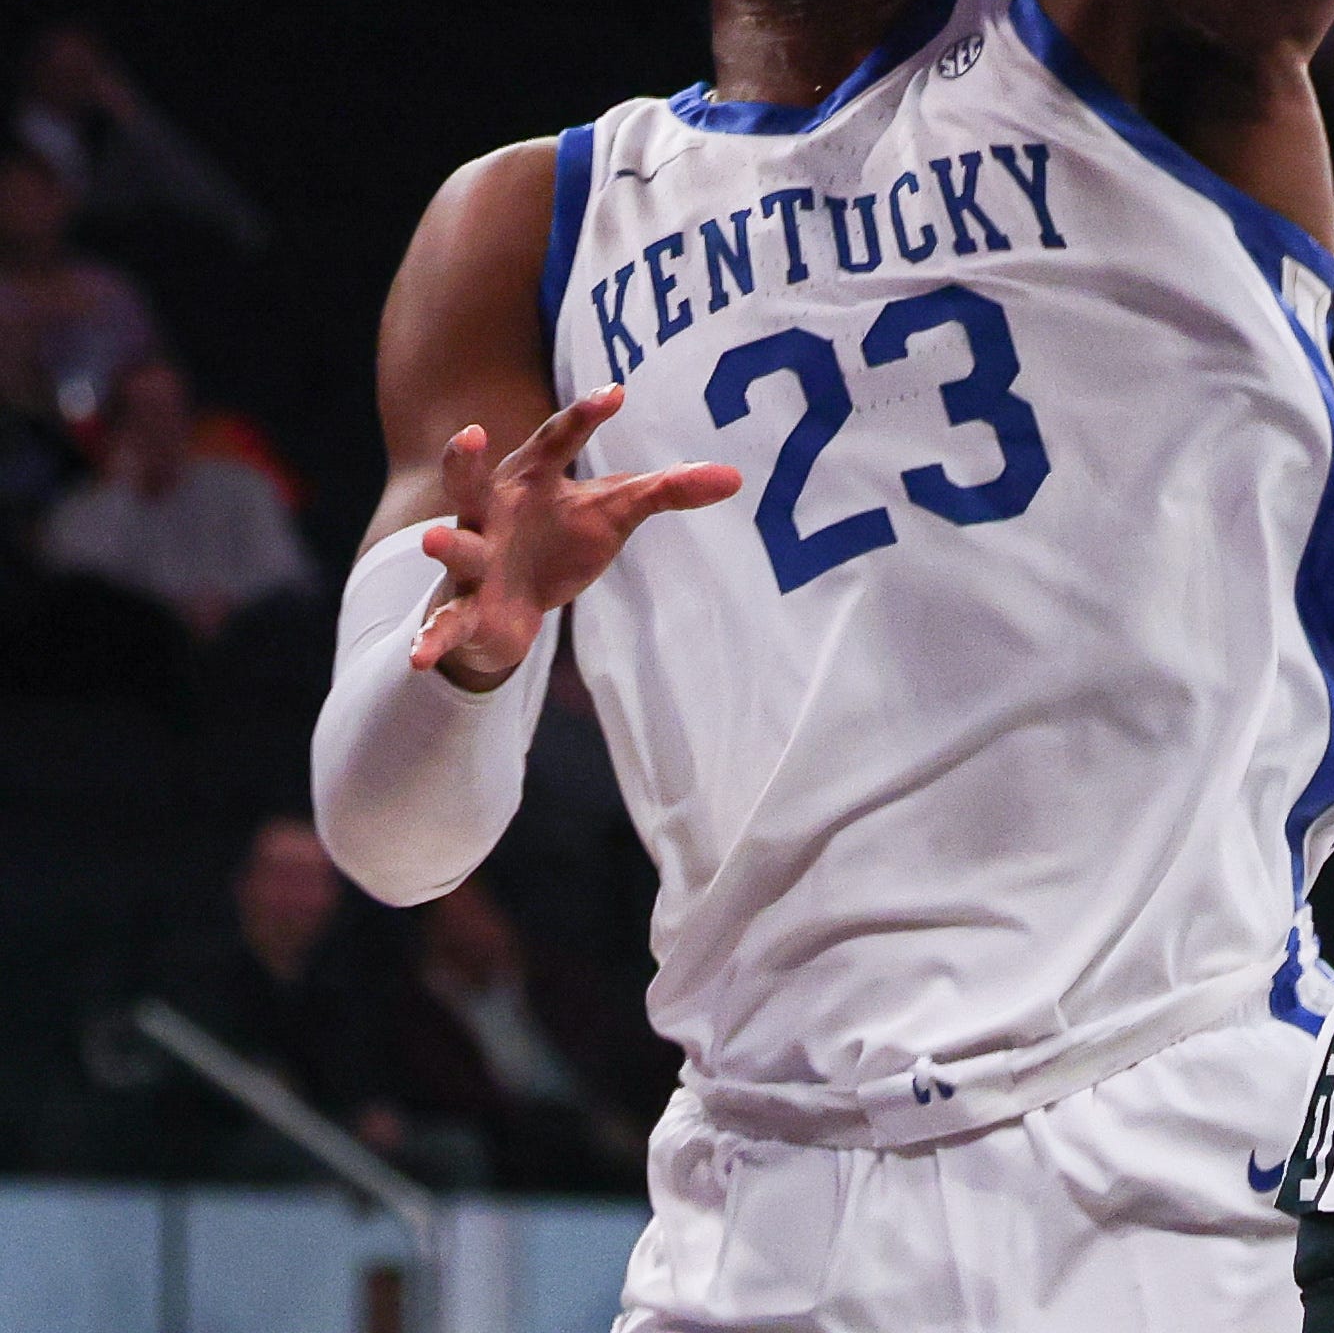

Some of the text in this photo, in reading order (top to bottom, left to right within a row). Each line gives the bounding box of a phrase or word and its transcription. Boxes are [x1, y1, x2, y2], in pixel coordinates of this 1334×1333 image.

[938, 35, 984, 78] SEC
[591, 143, 1067, 386] KENTUCKY
[703, 285, 1052, 596] 23
